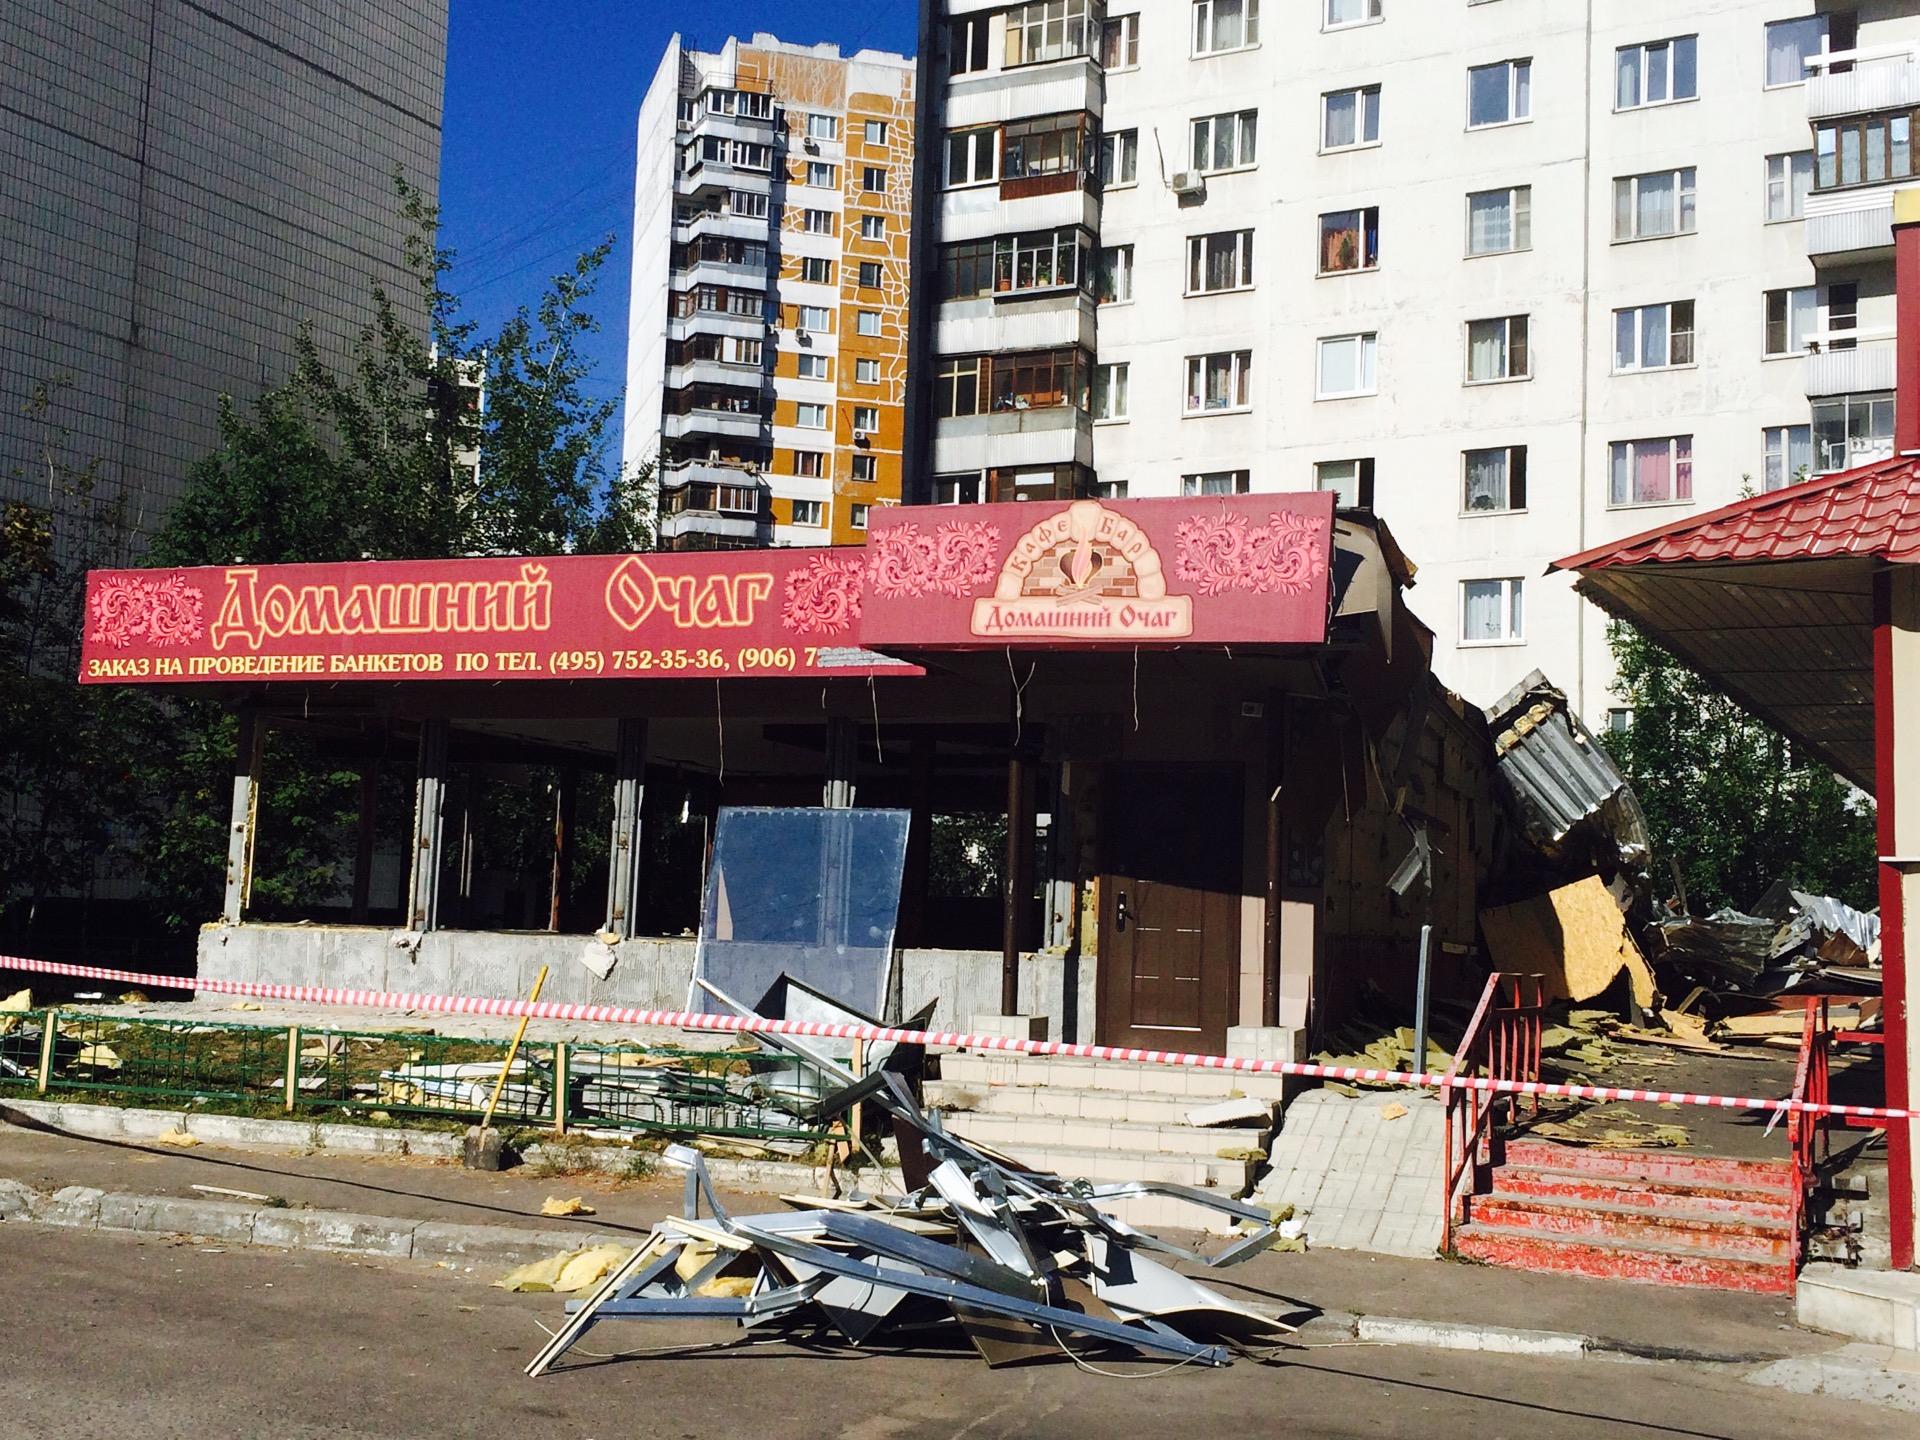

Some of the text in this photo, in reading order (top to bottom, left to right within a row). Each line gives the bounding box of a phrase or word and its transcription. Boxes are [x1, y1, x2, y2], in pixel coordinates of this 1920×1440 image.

[1099, 517, 1142, 555] Бар
[210, 555, 774, 651] Домашний Очаг
[985, 604, 1177, 631] Домашний Очаг
[88, 658, 150, 677] ЗАКАЗ
[154, 658, 184, 675] НА
[188, 655, 325, 675] ПРОВЕДЕНИЕ
[330, 653, 444, 673] БАНКЕТОВ
[455, 652, 490, 672] ПО
[495, 652, 543, 671] ТЕЛ.
[549, 651, 605, 674] (495)
[612, 648, 731, 671] 752-35-36,
[737, 647, 797, 672] (906)
